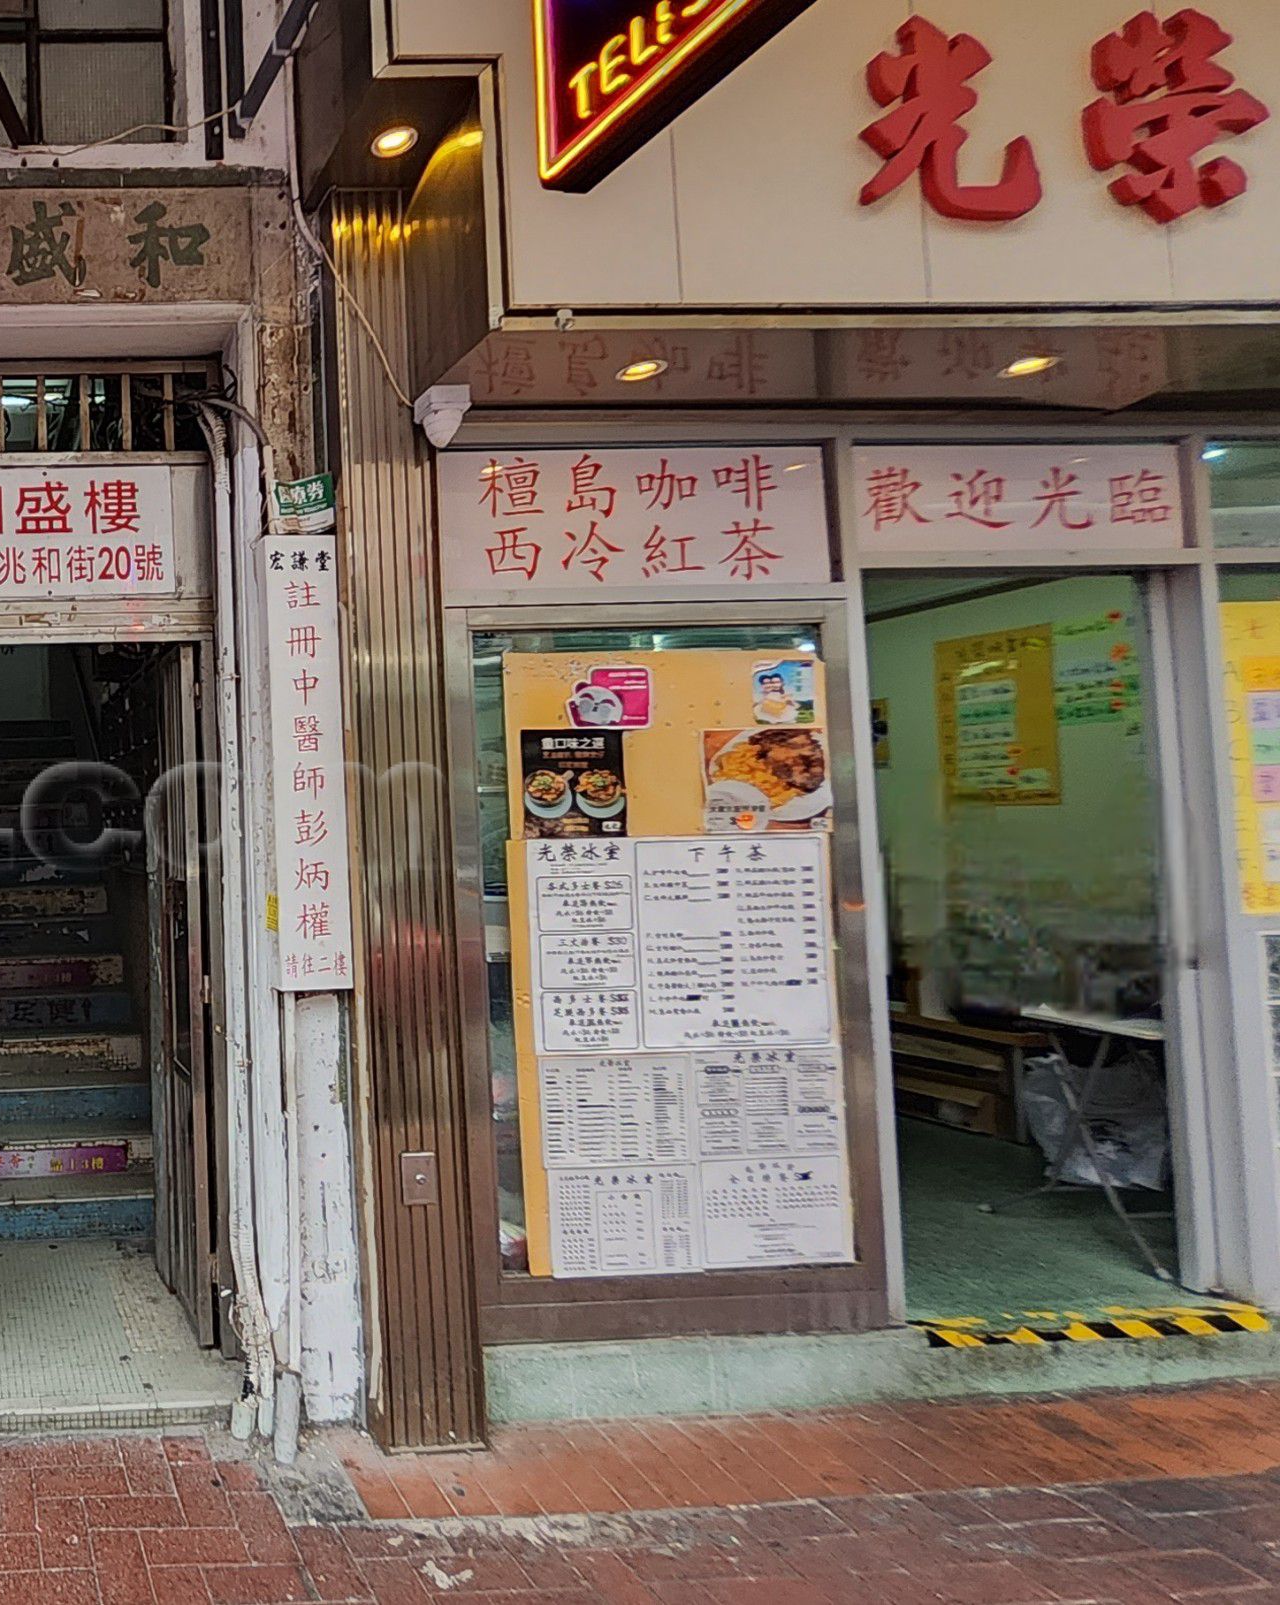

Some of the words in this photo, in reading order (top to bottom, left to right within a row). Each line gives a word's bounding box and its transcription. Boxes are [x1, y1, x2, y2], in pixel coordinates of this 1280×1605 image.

[859, 12, 1270, 224] 光榮
[477, 453, 778, 519] 檀島咖啡
[864, 467, 1176, 532] 歡迎光臨
[484, 518, 785, 583] 西冷紅茶
[283, 579, 332, 940] 註冊中醫師彭炳權
[537, 841, 622, 862] 光榮冰室
[687, 844, 767, 863] 下午茶
